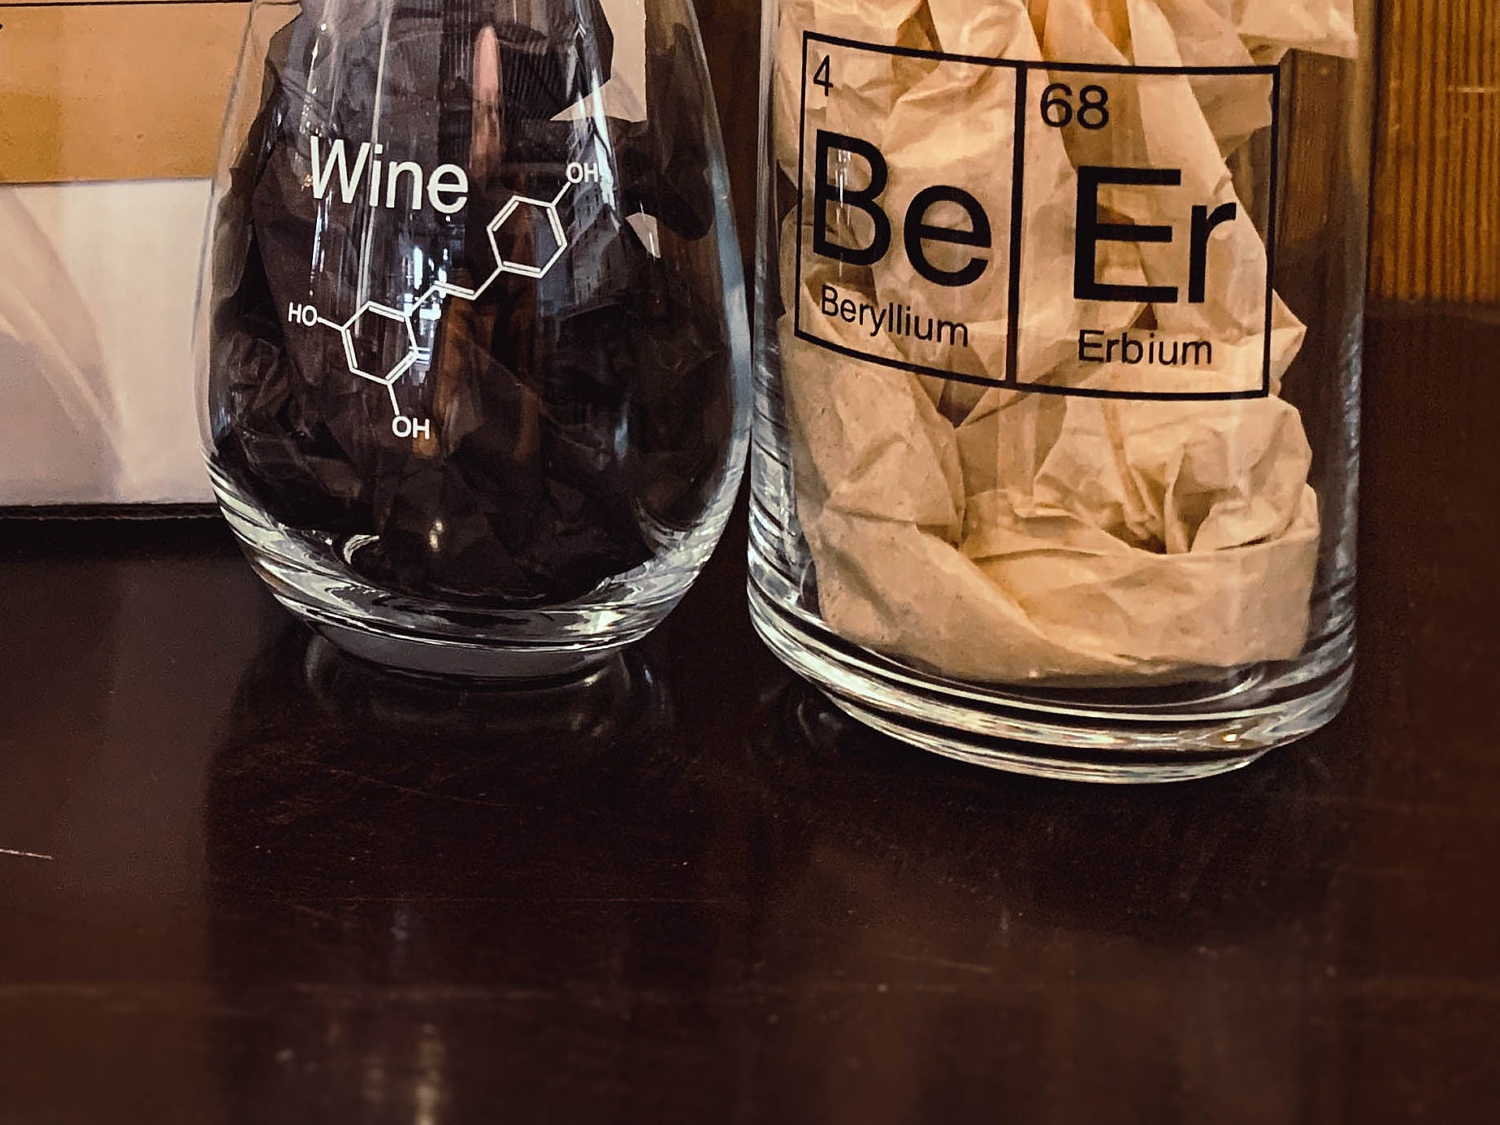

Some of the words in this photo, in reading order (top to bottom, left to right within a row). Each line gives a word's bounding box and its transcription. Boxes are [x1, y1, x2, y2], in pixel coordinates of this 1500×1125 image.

[812, 55, 834, 97] 4
[1040, 83, 1110, 130] 68
[310, 135, 469, 214] Wine
[566, 161, 599, 184] OH
[812, 129, 992, 287] Be
[1073, 166, 1237, 304] Er
[288, 302, 318, 326] HO
[821, 284, 969, 347] Beryllium
[1077, 329, 1213, 365] Erbium
[392, 416, 430, 439] OH
